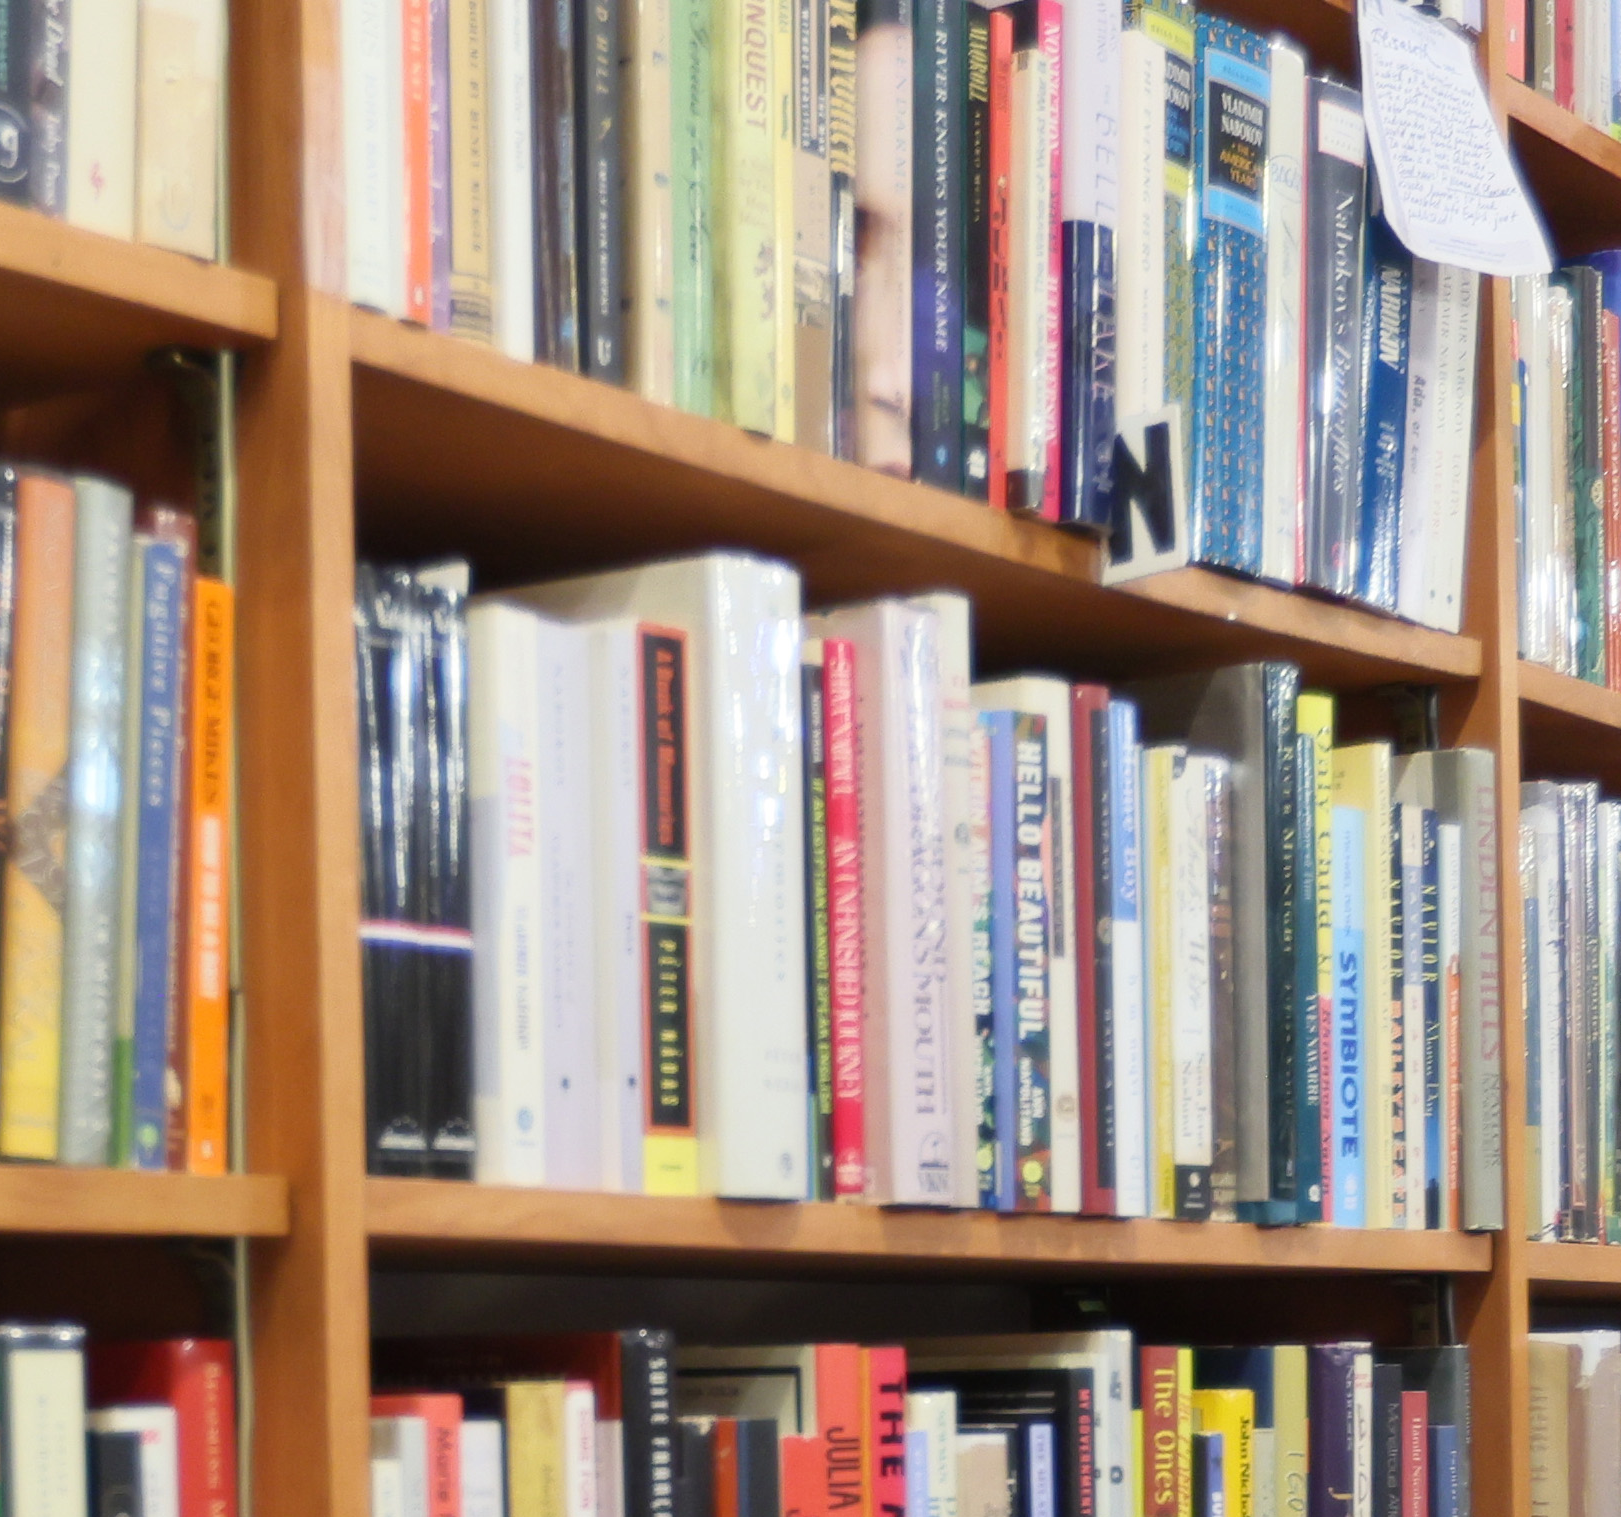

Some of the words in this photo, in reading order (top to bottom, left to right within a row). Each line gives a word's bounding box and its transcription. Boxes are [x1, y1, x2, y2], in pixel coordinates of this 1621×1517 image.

[934, 29, 949, 101] RIVER
[934, 110, 949, 200] KNOWS
[1093, 111, 1119, 223] BELL
[934, 206, 949, 273] YOUR
[1331, 192, 1356, 335] Nabokov's
[934, 279, 950, 353] NAME
[1329, 345, 1356, 495] Butterflies
[1110, 420, 1176, 567] N
[1448, 453, 1463, 519] LOLITA
[145, 562, 178, 694] Fugitive
[145, 706, 174, 808] Pieces
[1016, 742, 1044, 845] HELLO
[1476, 785, 1497, 935] LINDEN
[972, 930, 991, 1015] REACH
[1016, 857, 1045, 1041] BEAUTIFUL
[912, 970, 937, 1115] MOUTH
[1339, 950, 1360, 1159] SYMBIOTE
[1479, 951, 1500, 1062] HILLS
[879, 1379, 906, 1479] THE
[1153, 1365, 1178, 1419] The
[1238, 1415, 1252, 1450] John
[435, 1427, 455, 1503] Marie
[825, 1424, 863, 1511] JULIA
[1078, 1415, 1092, 1515] GOVERNMENT
[1154, 1429, 1178, 1506] Ones
